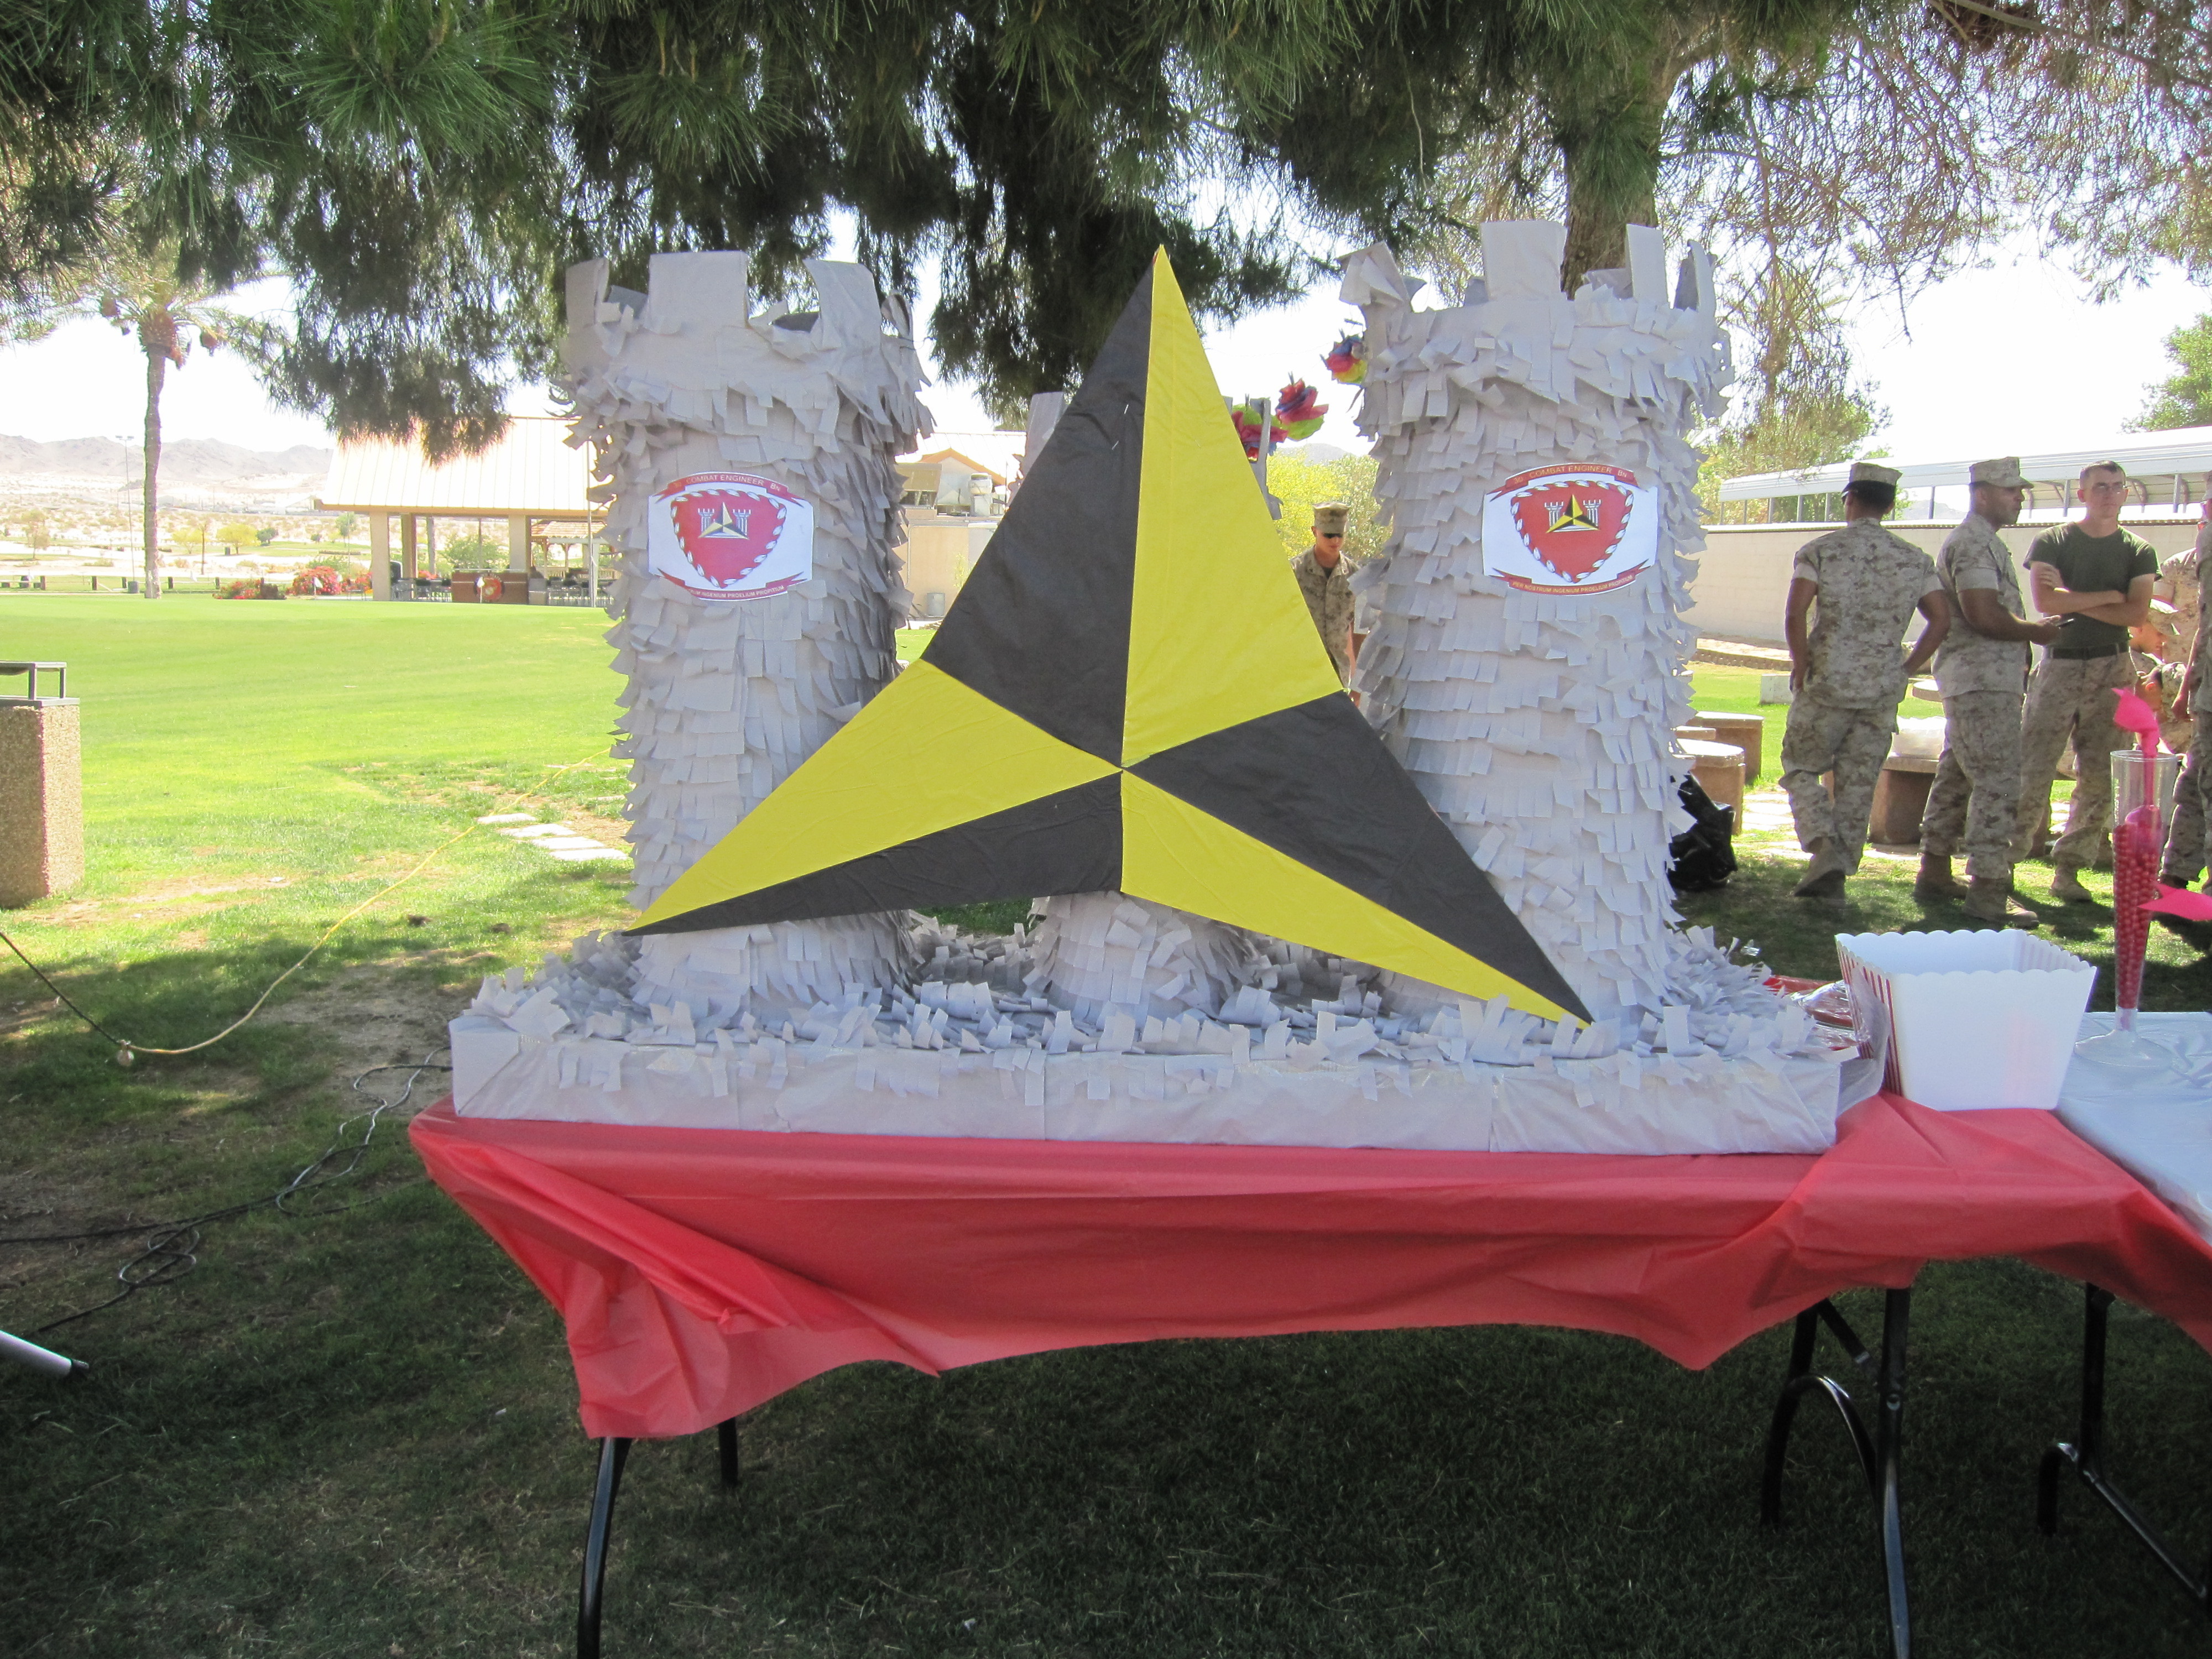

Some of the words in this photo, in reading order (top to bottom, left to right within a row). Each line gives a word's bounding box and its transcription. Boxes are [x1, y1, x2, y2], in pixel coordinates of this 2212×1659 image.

[1530, 466, 1566, 478] COMBAT
[1568, 465, 1613, 474] ENGINEER
[686, 474, 718, 484] COMBAT
[720, 474, 764, 486] ENGINEER
